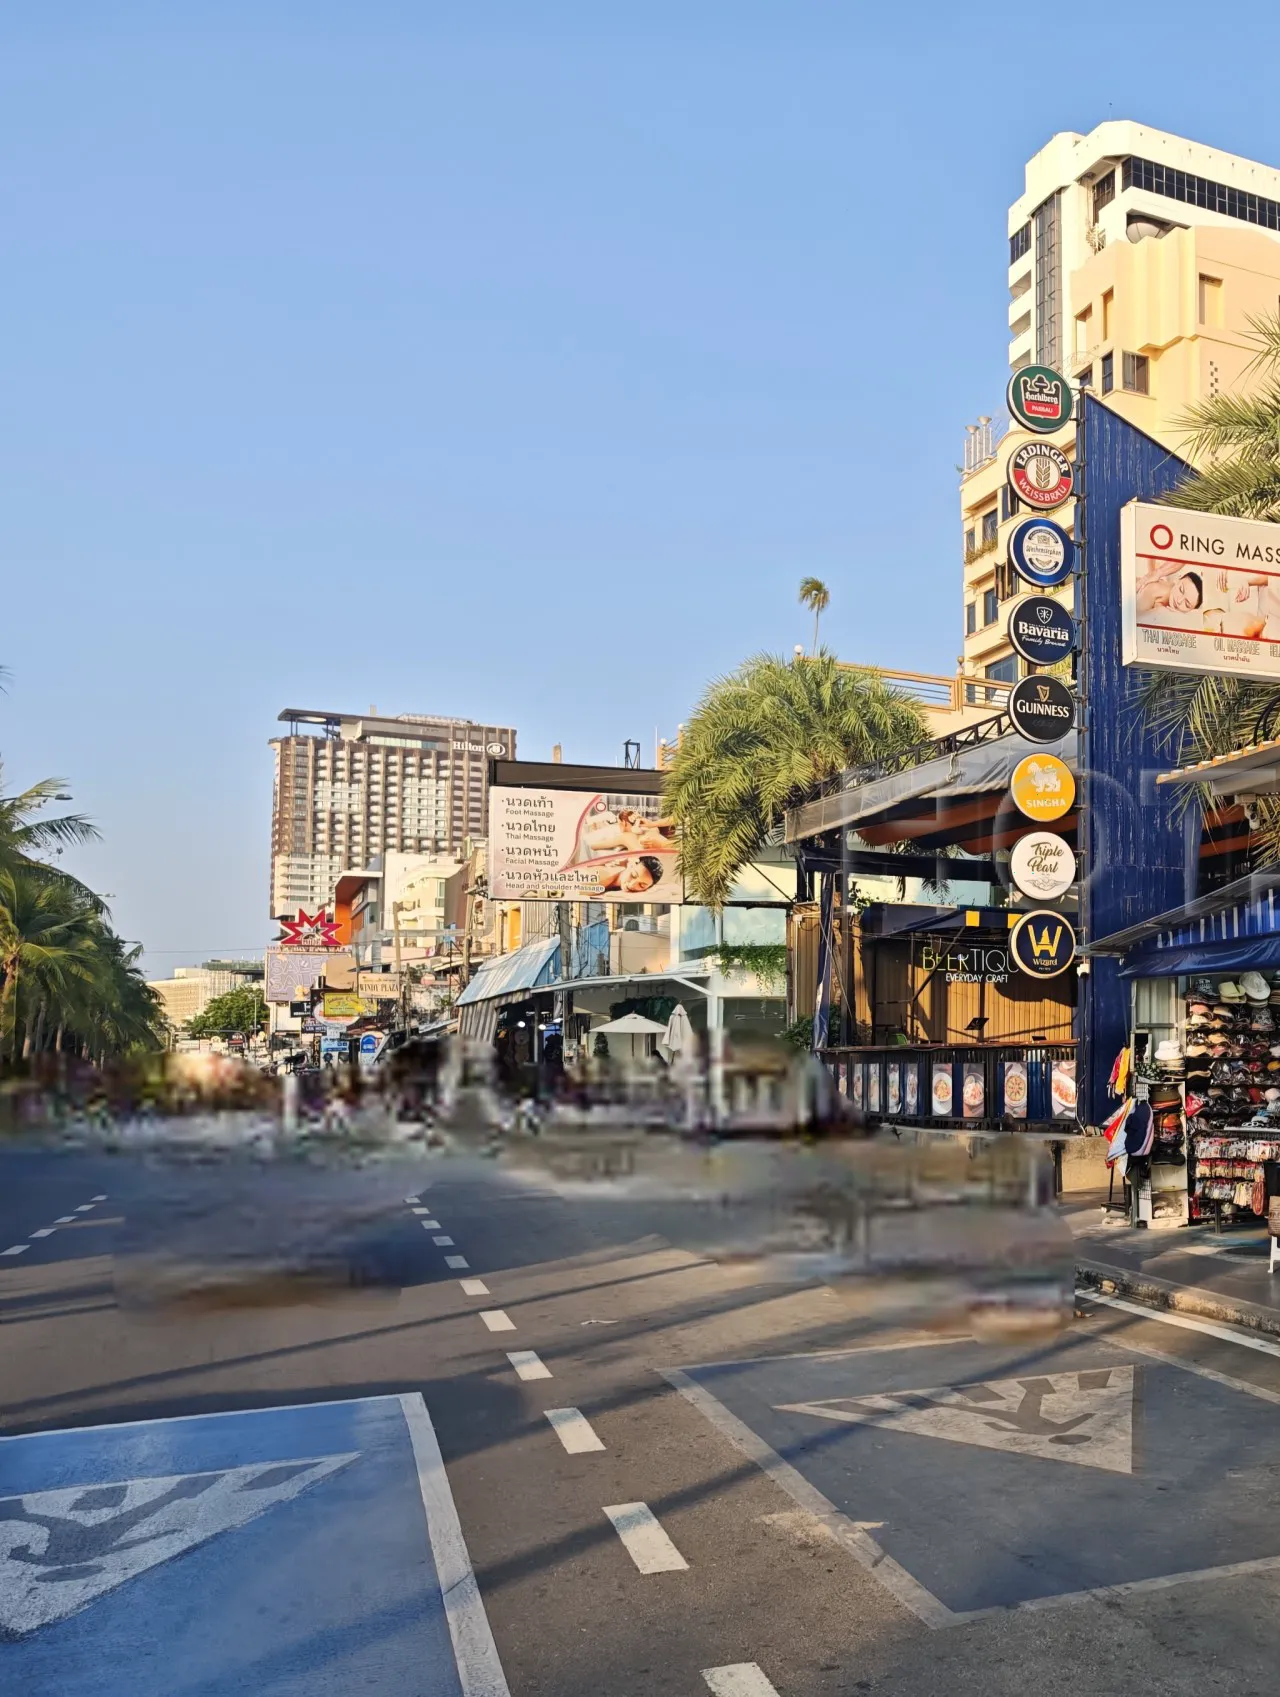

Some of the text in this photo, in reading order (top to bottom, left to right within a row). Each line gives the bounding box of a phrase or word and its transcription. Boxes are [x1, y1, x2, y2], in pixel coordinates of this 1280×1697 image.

[1016, 444, 1069, 472] ERDINGER
[1180, 533, 1225, 556] RING
[1019, 621, 1069, 641] Bavaria
[1142, 629, 1197, 649] THAI MASSAGE
[1213, 637, 1260, 655] OIL MASSAGE
[1016, 699, 1069, 718] GUINNESS
[453, 741, 485, 752] Hilton
[505, 796, 554, 809] นวดเท้า
[1026, 799, 1066, 808] SINGHA
[505, 808, 554, 818] Foot Massage
[505, 819, 556, 833] นวดไทย
[522, 834, 554, 842] Massage
[505, 844, 558, 858] นวดหน้า
[1031, 841, 1064, 861] Triple
[528, 858, 559, 866] Massage
[1027, 856, 1058, 873] Pearl
[526, 882, 540, 890] and
[541, 882, 572, 891] shoulder
[574, 883, 605, 892] Massage
[1032, 958, 1057, 966] Wizard
[945, 973, 1008, 983] EVERYDAY CRAFT
[381, 983, 399, 992] PLAZA
